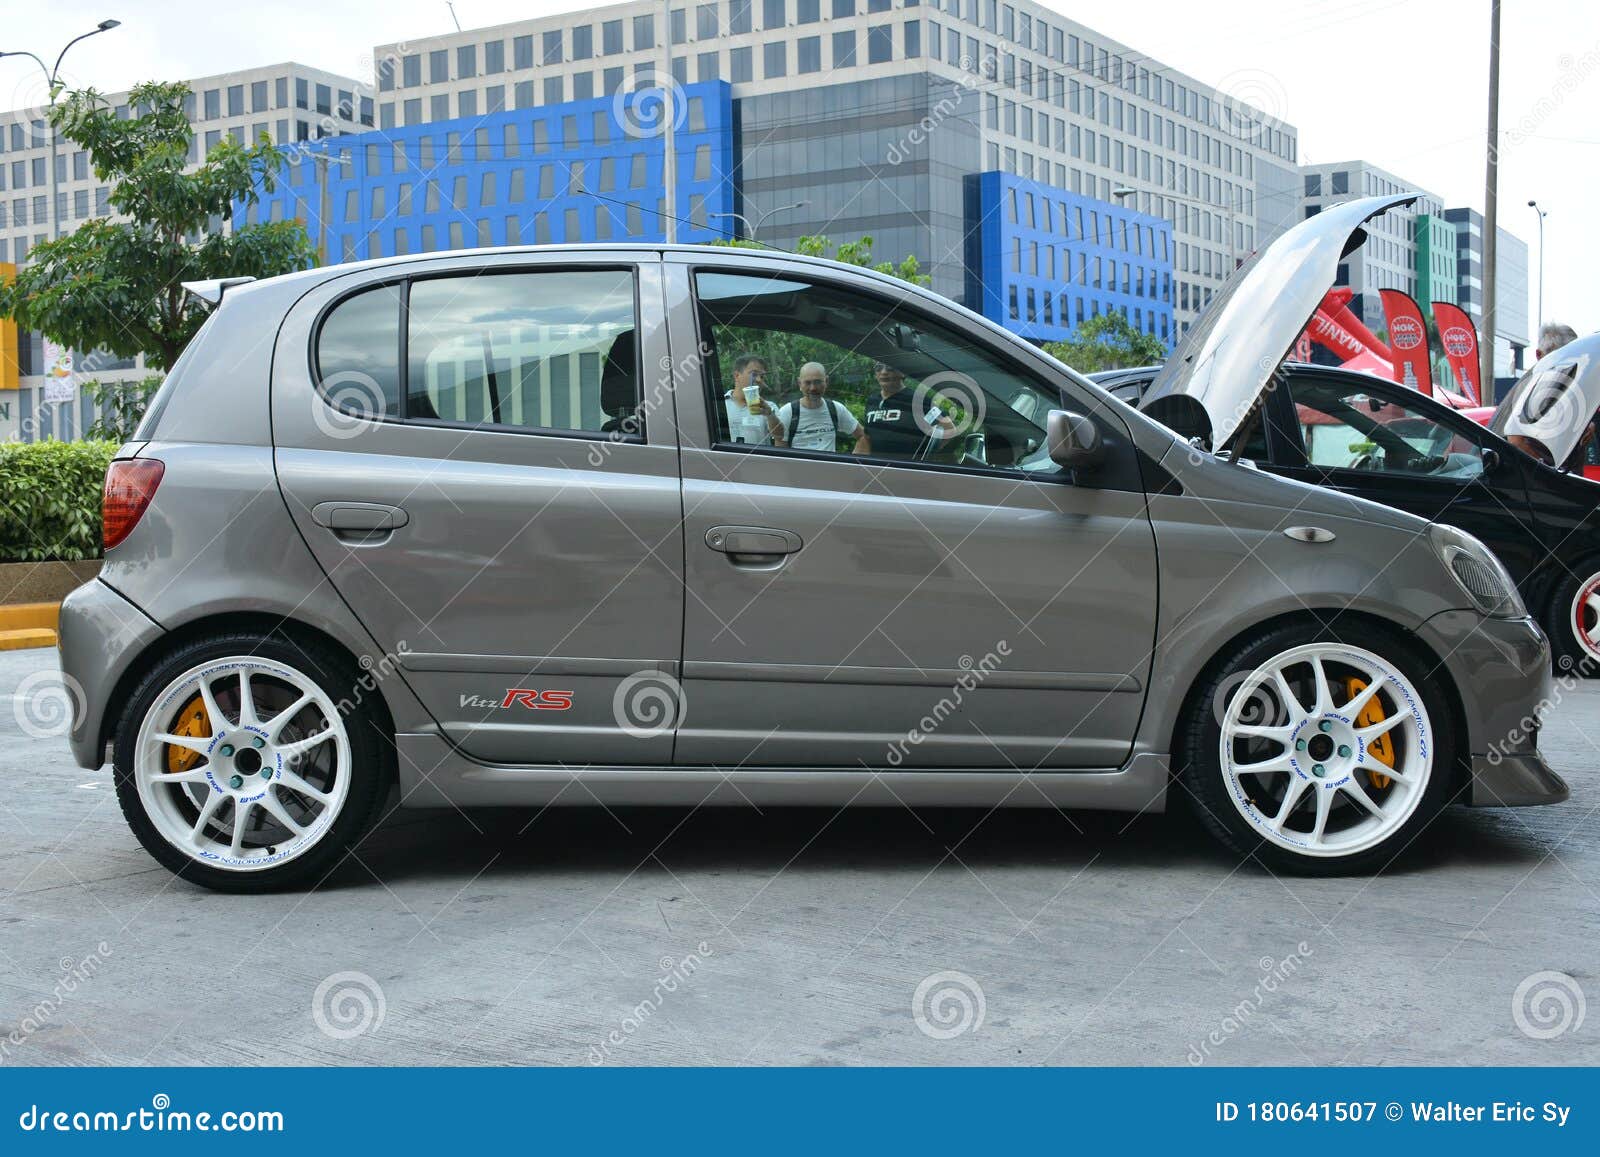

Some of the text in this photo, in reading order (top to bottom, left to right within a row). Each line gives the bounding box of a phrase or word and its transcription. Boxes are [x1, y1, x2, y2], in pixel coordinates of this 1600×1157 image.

[1313, 314, 1363, 353] MANIL
[867, 409, 901, 424] TRD
[460, 688, 574, 711] Vitz RS
